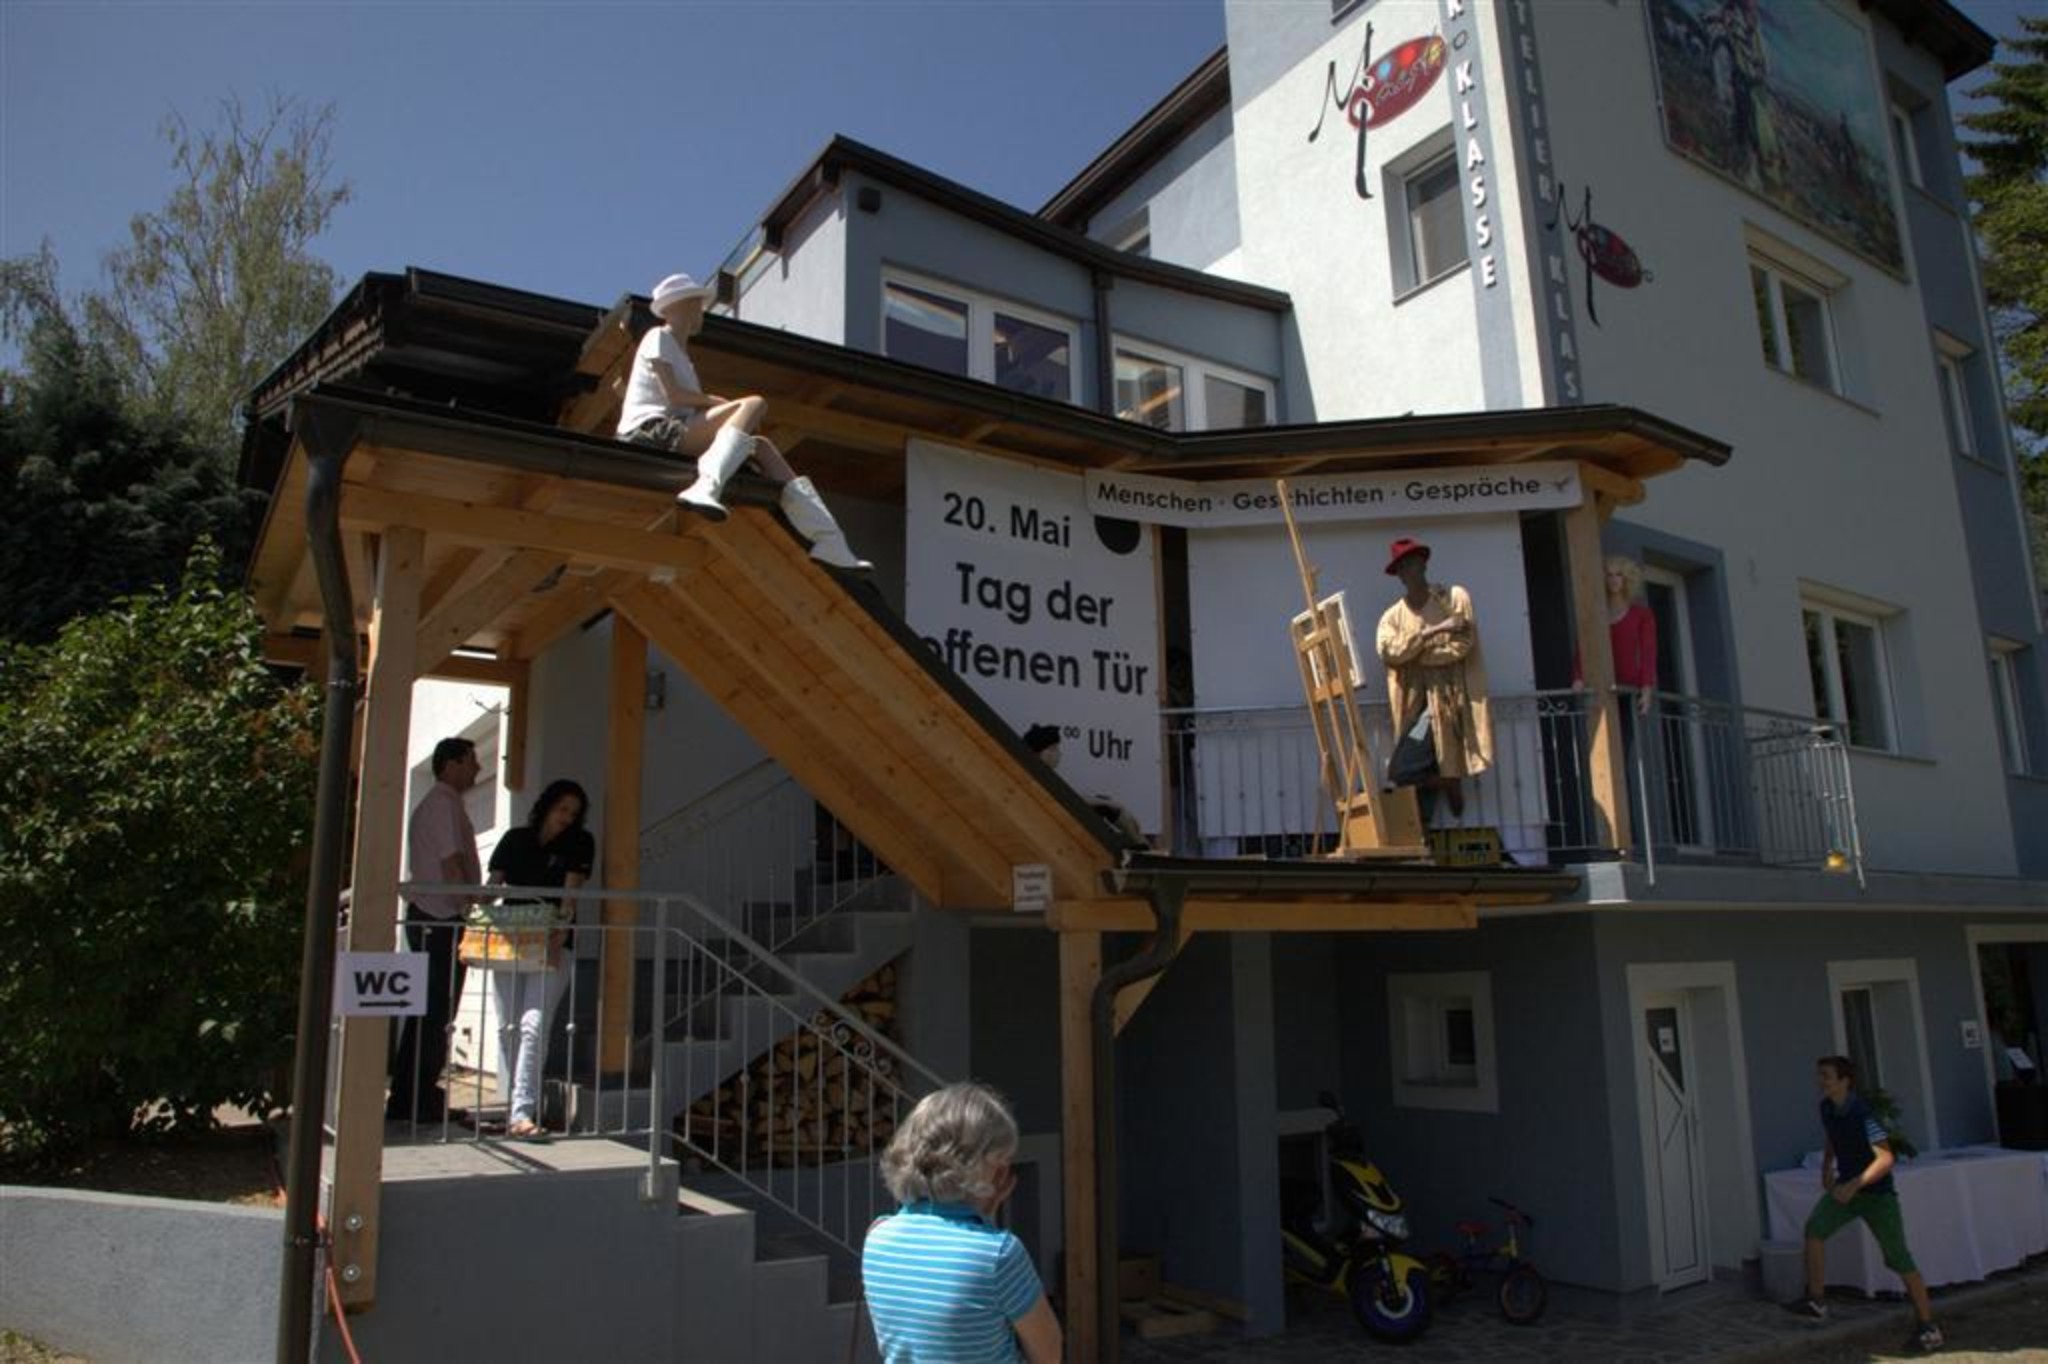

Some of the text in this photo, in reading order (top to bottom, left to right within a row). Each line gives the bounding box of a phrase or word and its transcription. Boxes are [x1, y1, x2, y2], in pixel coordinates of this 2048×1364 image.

[1455, 59, 1498, 289] KLASSE
[1549, 254, 1578, 399] KLAS
[944, 491, 1071, 548] 20. Mai
[1098, 482, 1212, 512] Menschen
[1404, 475, 1541, 502] Gespräche
[955, 561, 1114, 627] Tag der
[1092, 649, 1148, 696] Tür
[1088, 728, 1133, 761] Uhr
[354, 970, 411, 996] WC
